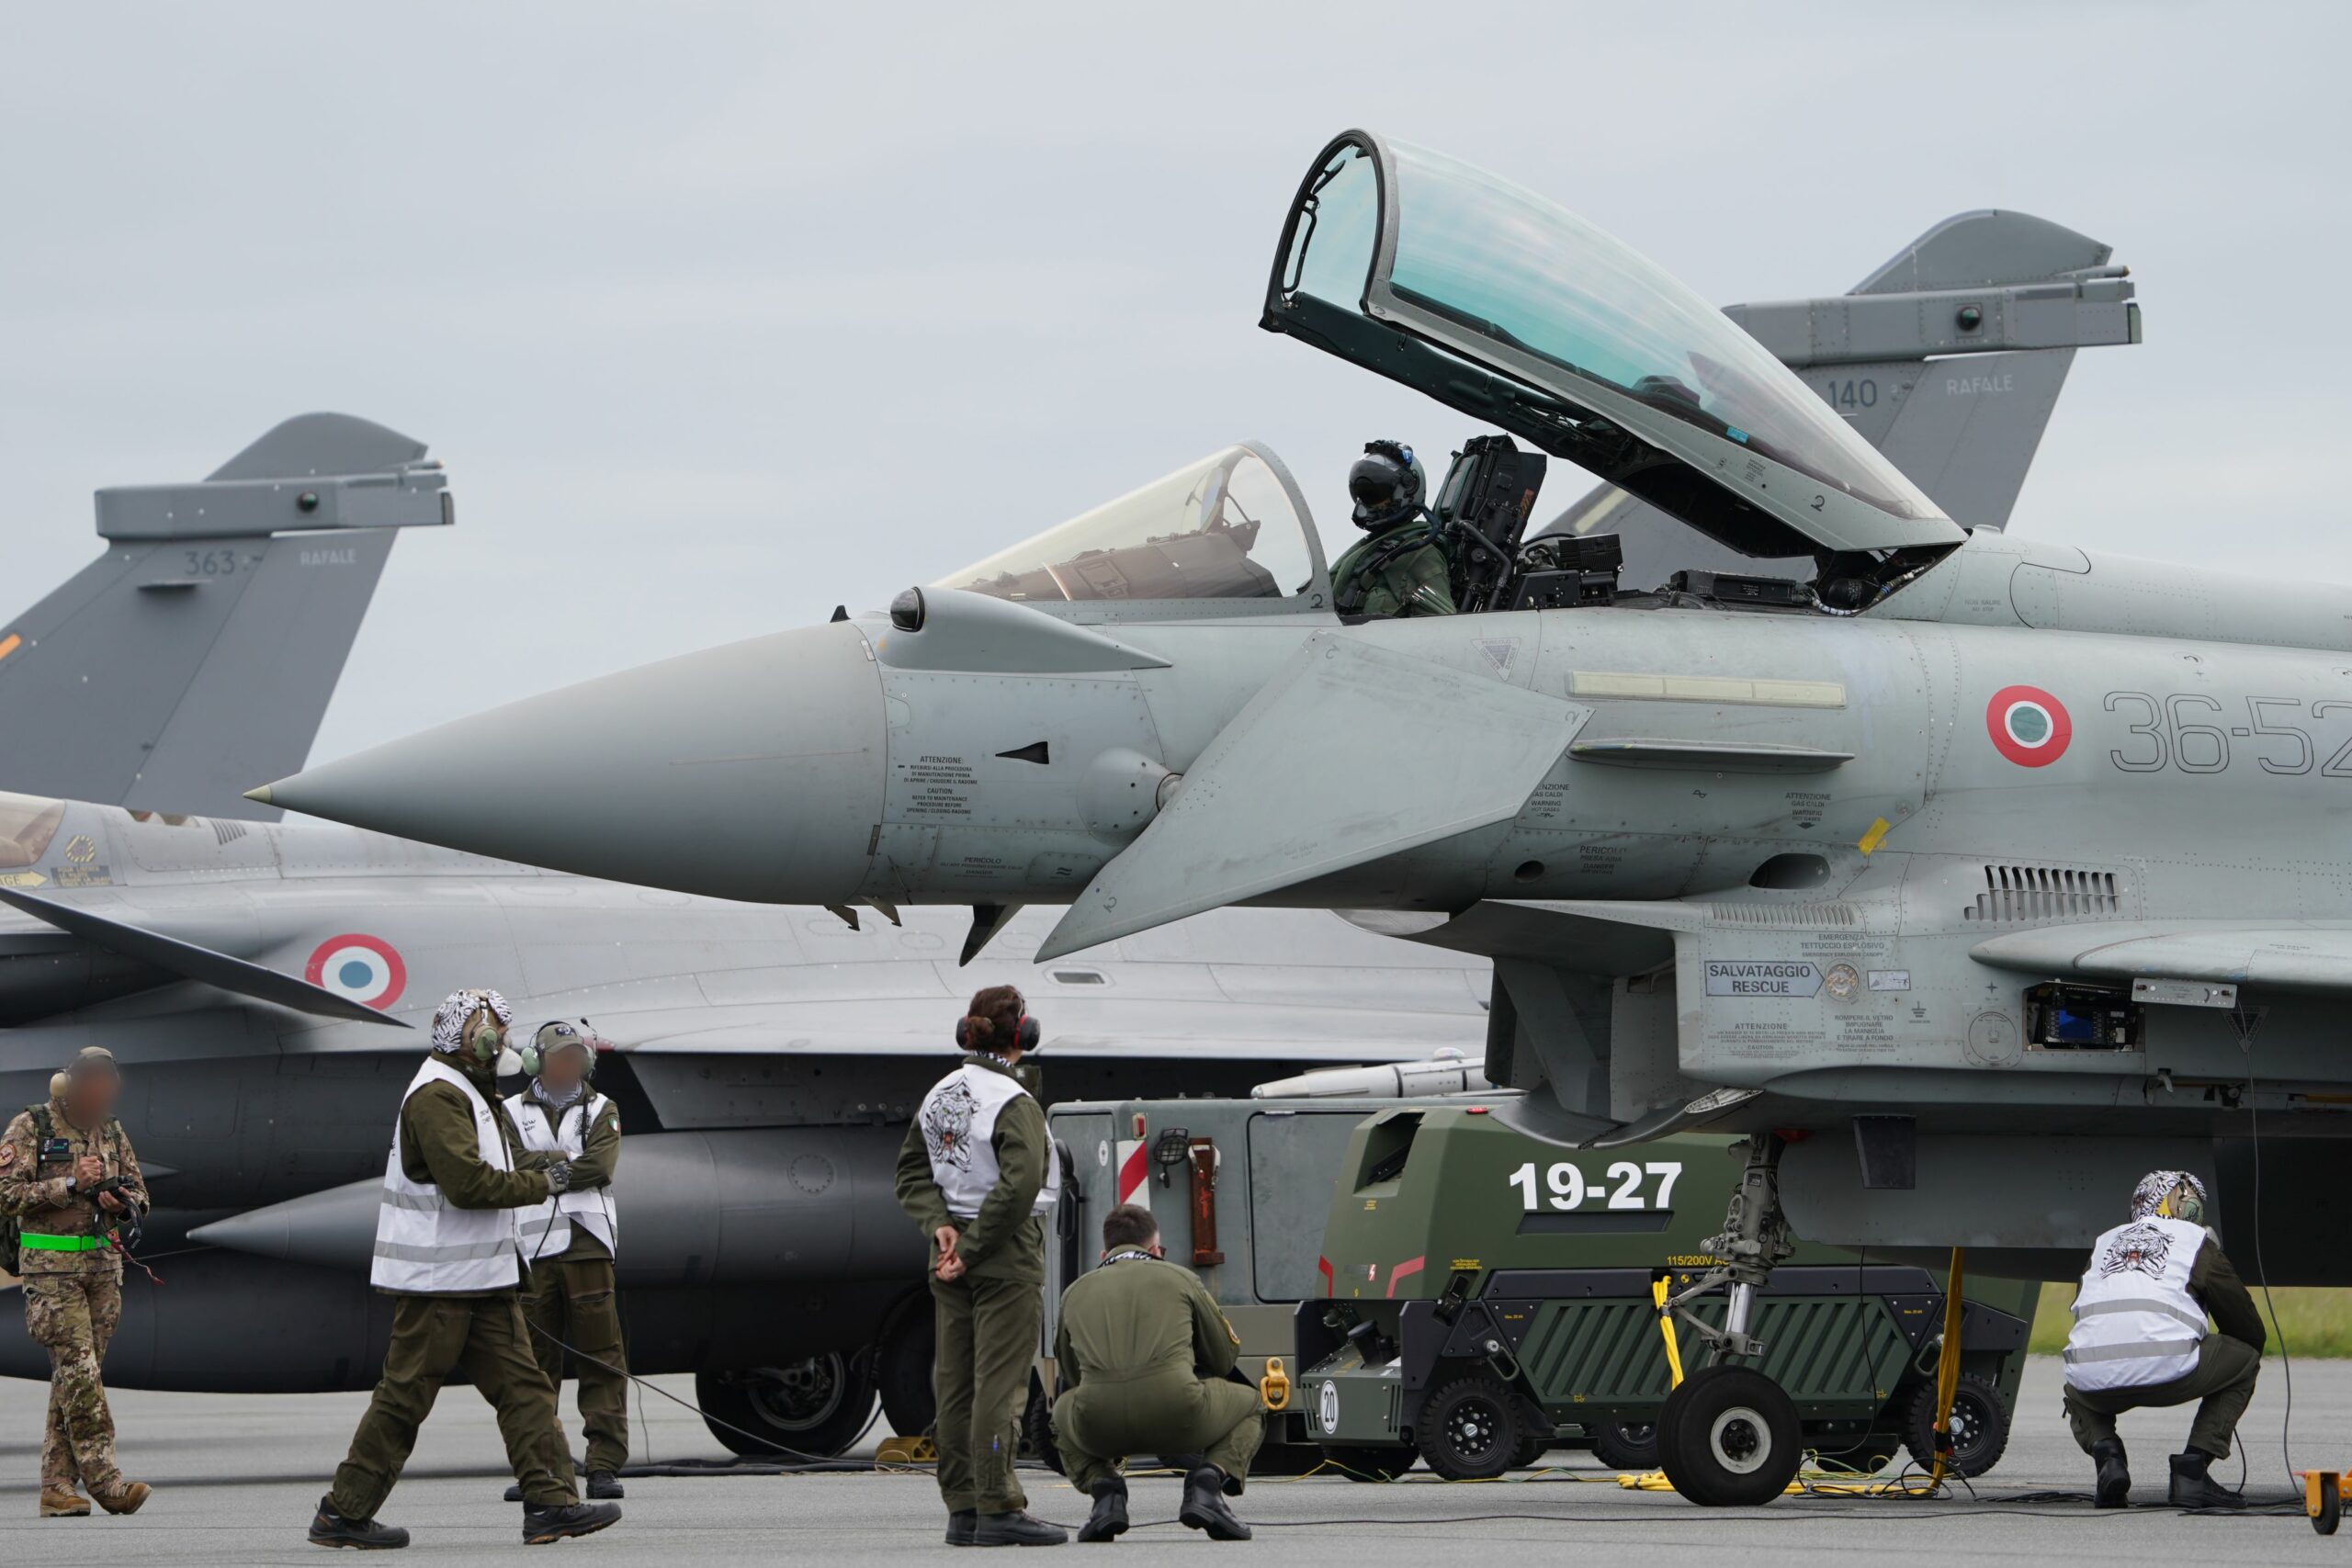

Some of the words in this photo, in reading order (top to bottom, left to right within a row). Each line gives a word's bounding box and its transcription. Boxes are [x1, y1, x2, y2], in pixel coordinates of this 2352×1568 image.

[1827, 378, 1877, 409] 140
[1947, 375, 2014, 396] RAFALE
[184, 550, 235, 576] 363
[300, 548, 358, 567] RAFALE
[2103, 691, 2352, 777] 36-52
[920, 756, 964, 764] ATTENZIONE:
[1785, 792, 1831, 800] ATTENZIONE
[964, 856, 1002, 864] PERICOLO
[1709, 964, 1811, 977] SALVATAGGIO
[1732, 980, 1790, 993] RESCUE
[1510, 1161, 1682, 1211] 19-27
[1667, 1255, 1713, 1266] 115/200V
[1324, 1390, 1336, 1423] 20
